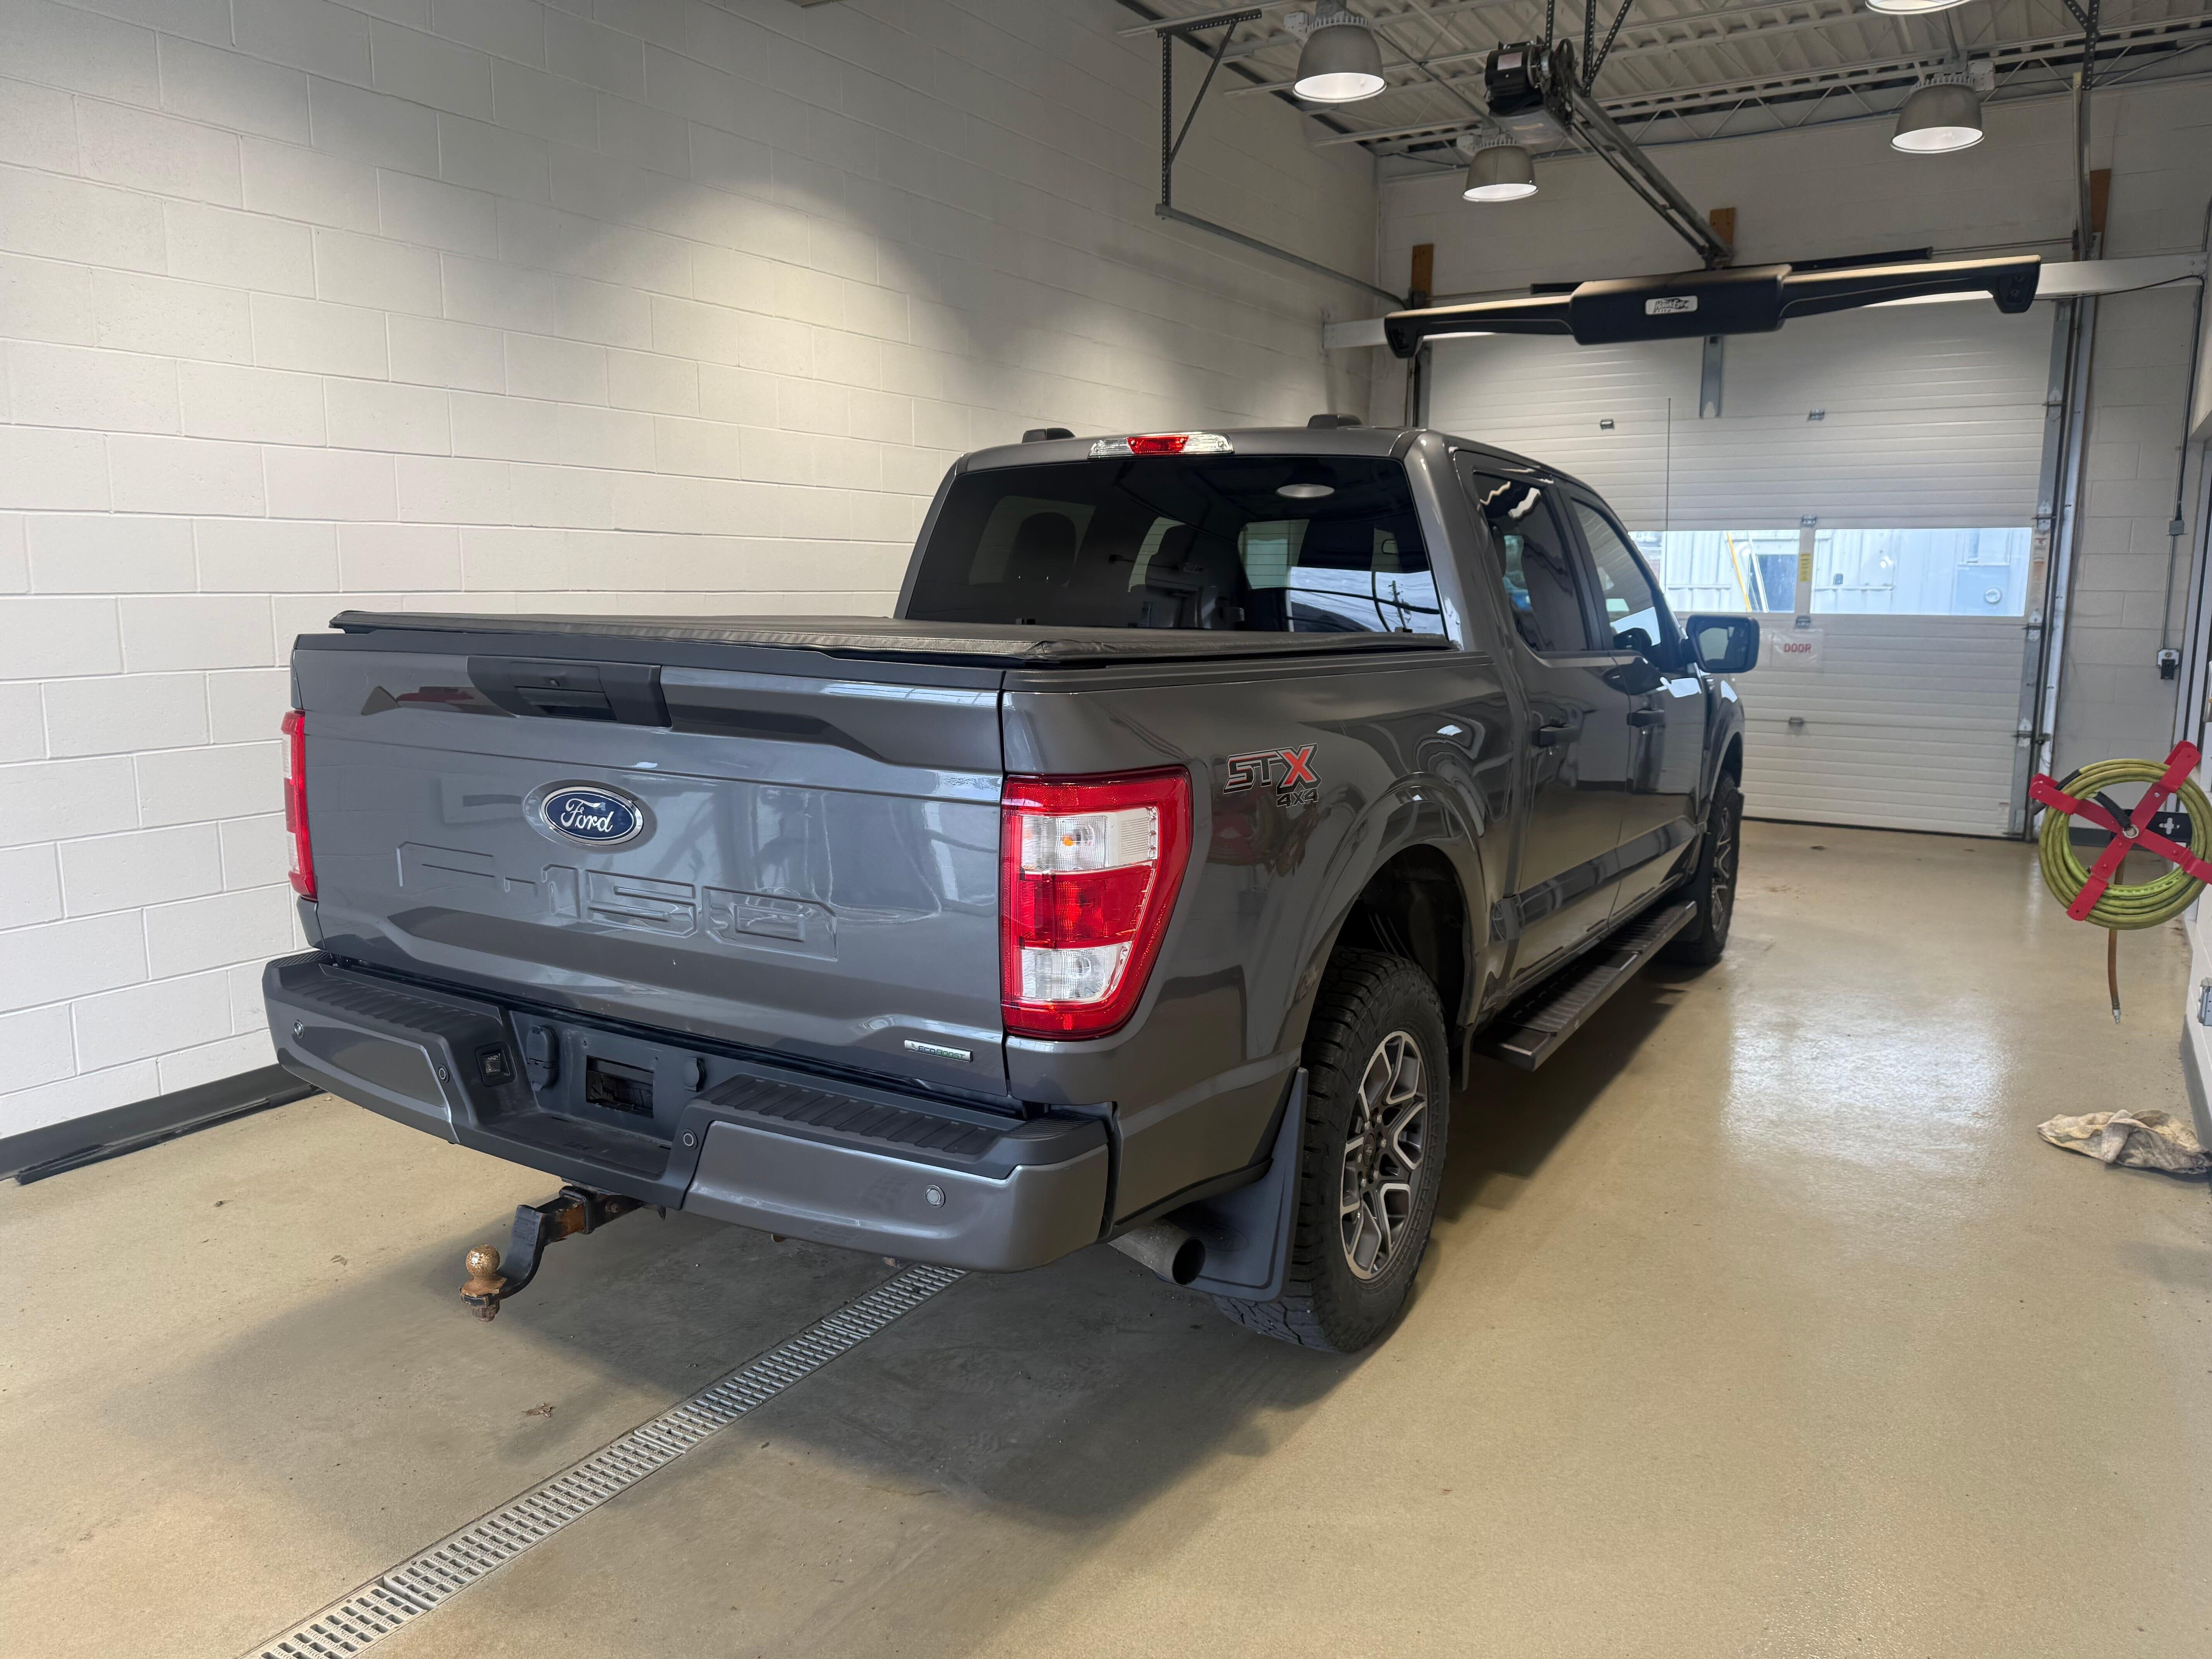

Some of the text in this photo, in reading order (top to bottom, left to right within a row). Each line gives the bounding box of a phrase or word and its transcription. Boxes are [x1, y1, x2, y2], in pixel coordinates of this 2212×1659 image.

[1784, 643, 1811, 653] DOOR
[1224, 743, 1322, 795] STX
[560, 798, 614, 832] Ford
[396, 841, 838, 962] F-150
